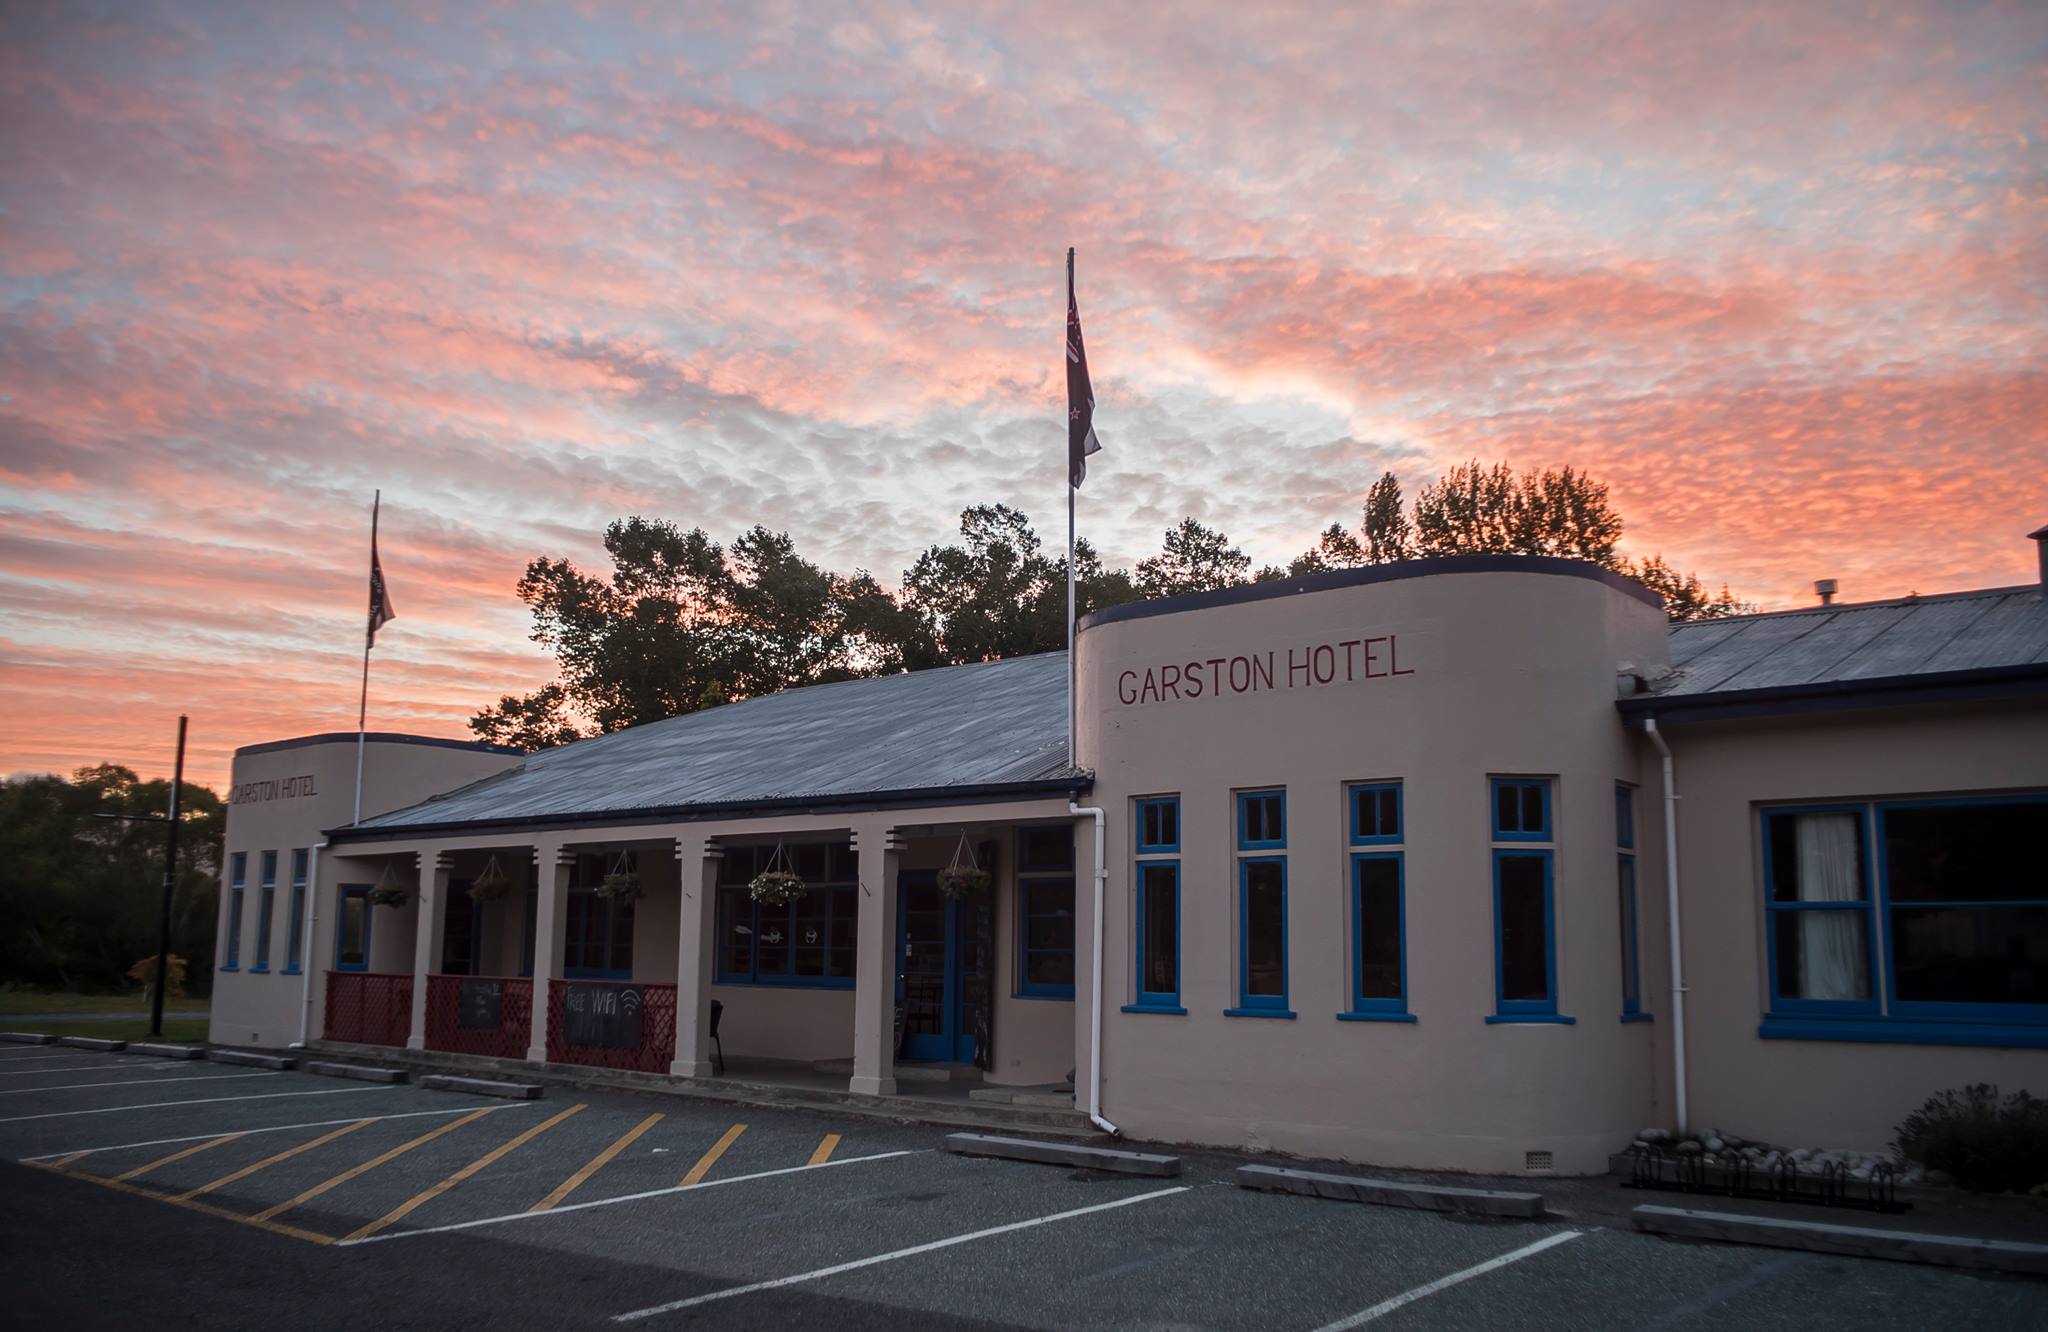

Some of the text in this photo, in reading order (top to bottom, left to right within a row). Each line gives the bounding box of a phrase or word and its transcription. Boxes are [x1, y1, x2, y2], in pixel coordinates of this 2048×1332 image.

[1118, 635, 1415, 705] GARSTON HOTEL
[232, 774, 318, 805] GARSTON HOTEL
